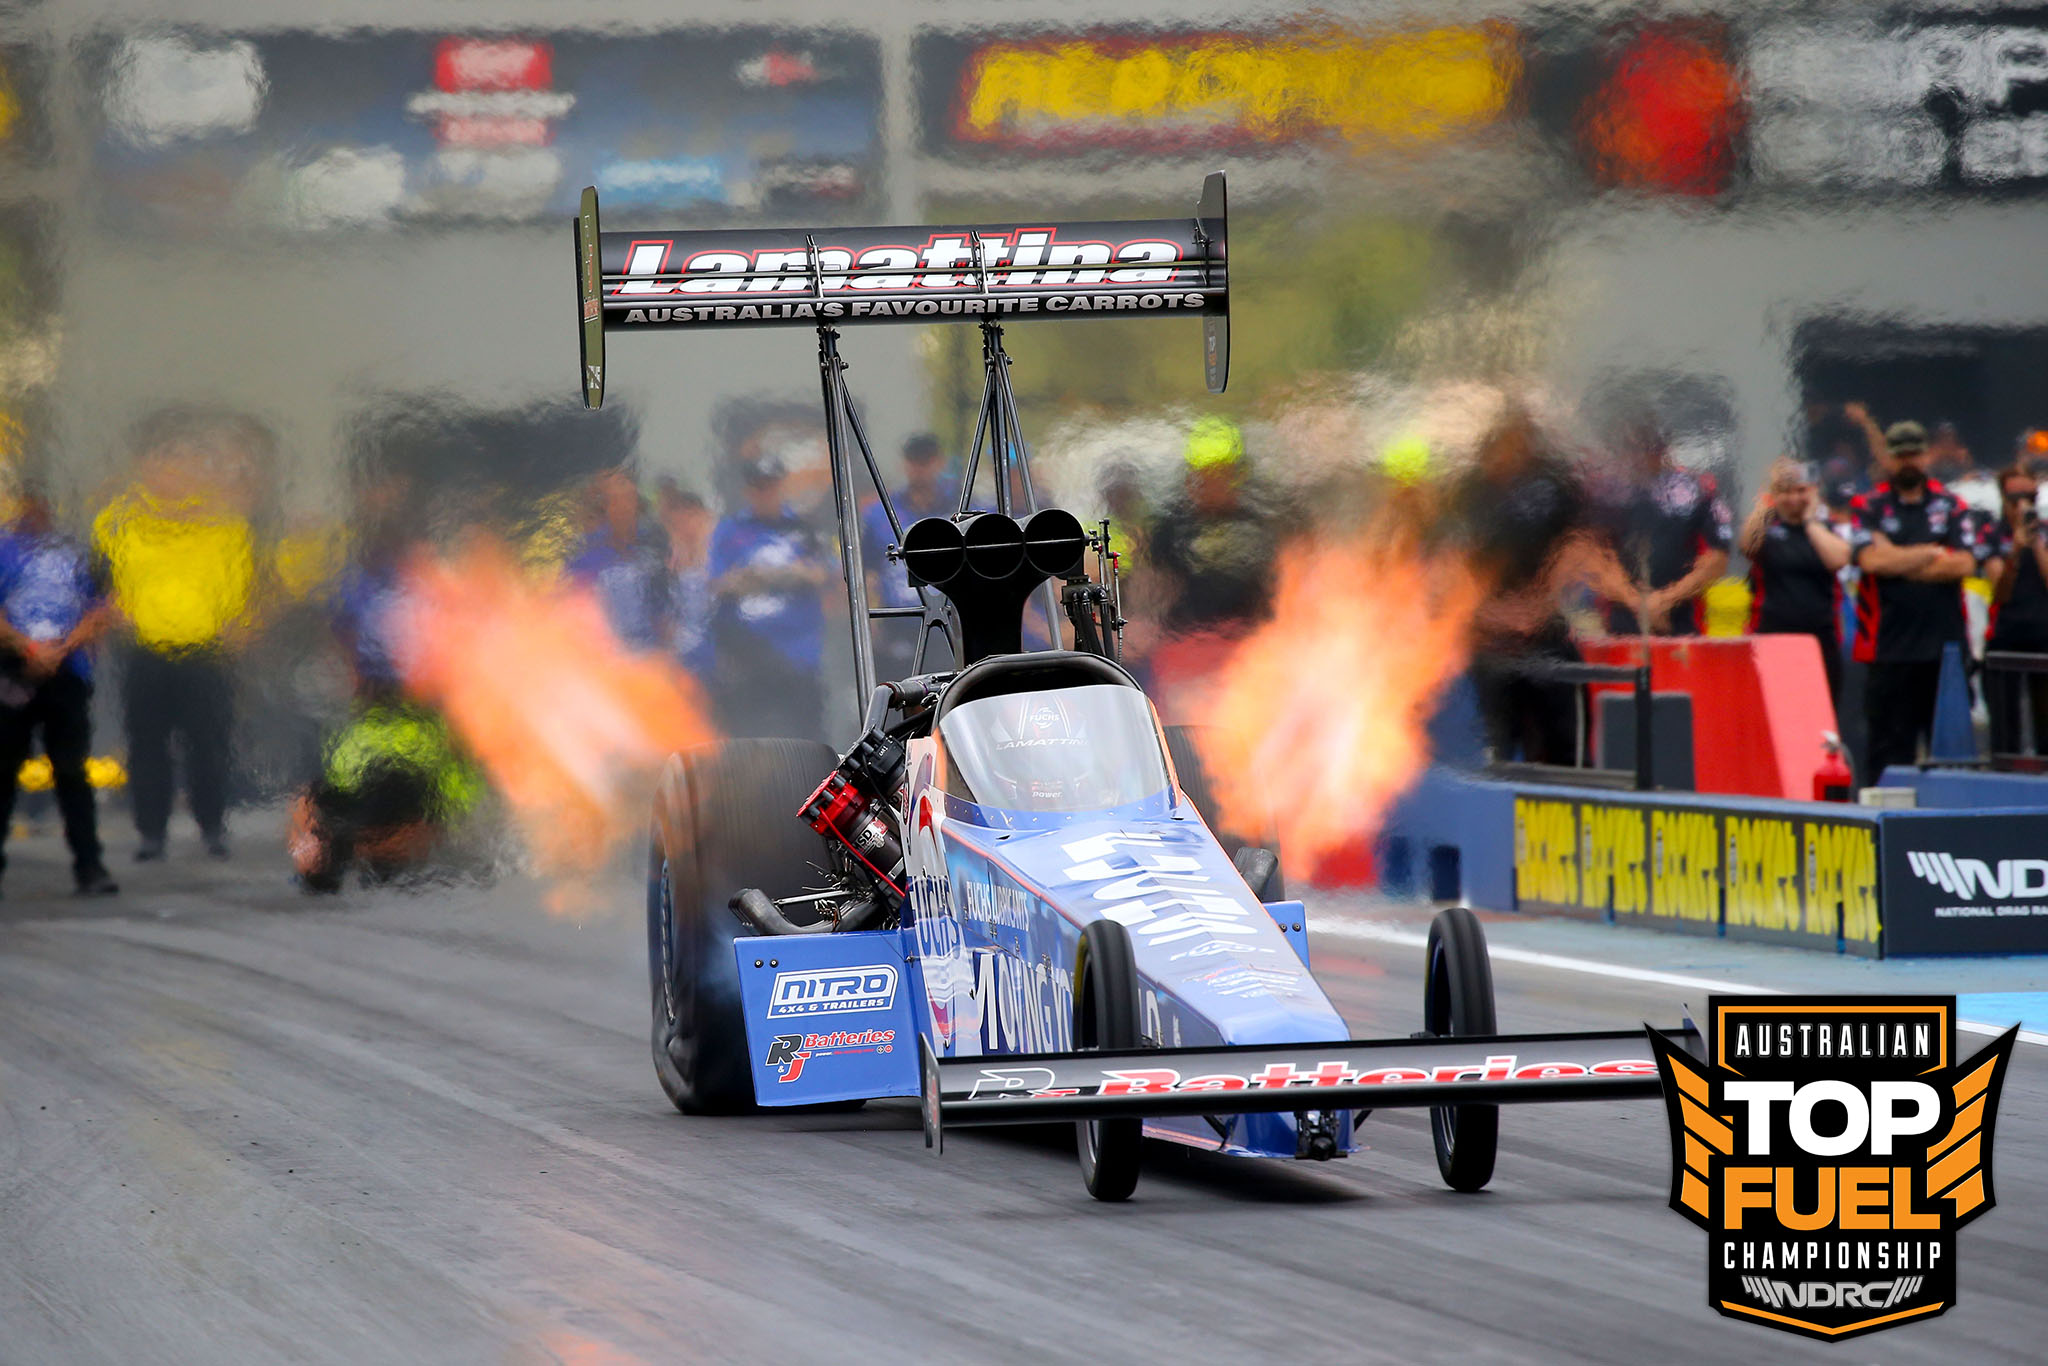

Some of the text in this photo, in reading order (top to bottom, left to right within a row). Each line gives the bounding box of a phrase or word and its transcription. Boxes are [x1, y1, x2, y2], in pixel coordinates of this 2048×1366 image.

[615, 229, 1181, 295] Lamattina
[624, 293, 1205, 323] AUSTRALIA'S FAVOURITE CARROTS
[782, 974, 888, 1000] NITRO
[778, 998, 884, 1014] 4X4 & TRAILERS
[803, 1030, 896, 1048] Batteries
[1096, 1056, 1657, 1096] Batteries
